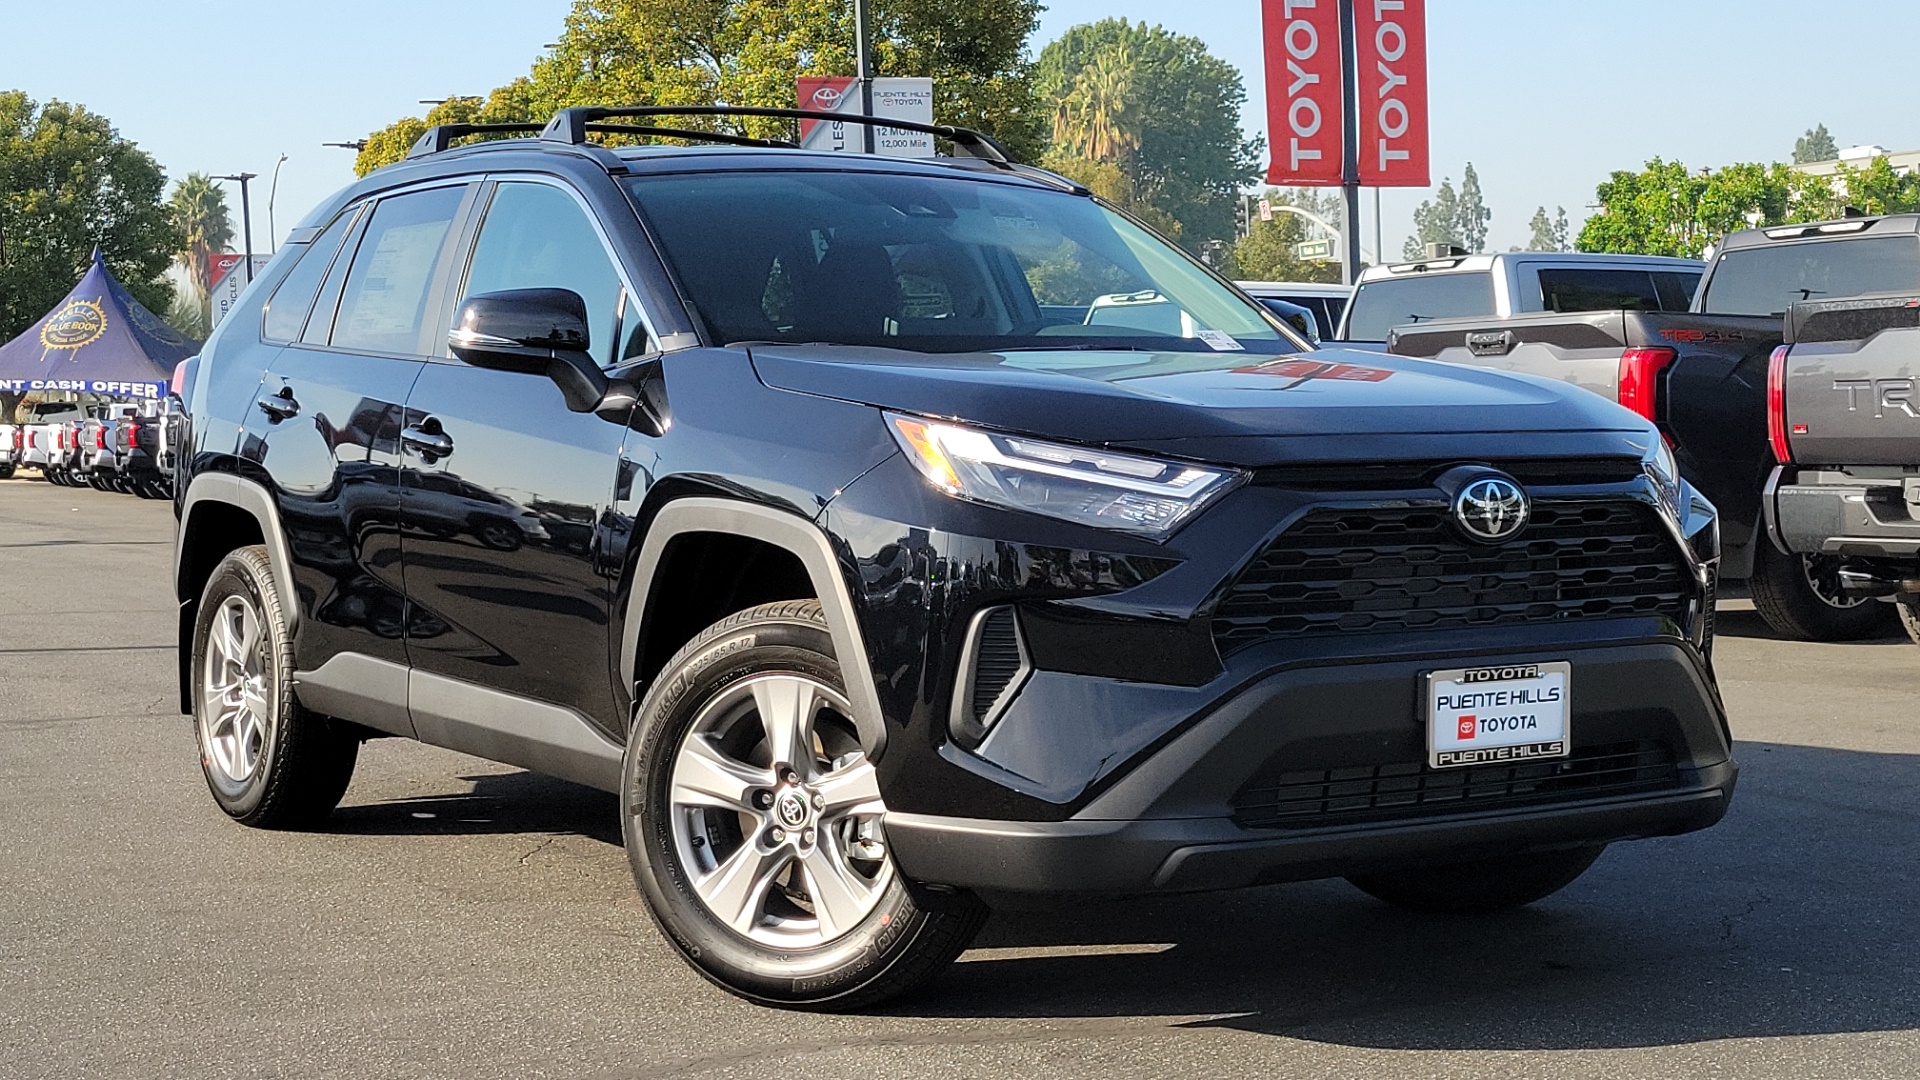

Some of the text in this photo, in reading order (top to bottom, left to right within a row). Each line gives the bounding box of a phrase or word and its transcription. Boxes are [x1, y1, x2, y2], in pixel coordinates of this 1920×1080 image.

[876, 127, 888, 136] 12
[881, 139, 928, 148] 12,000 Mile
[58, 306, 100, 321] KELLEY
[48, 321, 99, 333] BLUE BOOK
[30, 380, 86, 391] CASH
[92, 380, 158, 399] OFFER
[1465, 666, 1538, 683] TOYOTA
[1437, 687, 1560, 711] PUENTE HILLS
[1479, 714, 1538, 733] TOYOTA
[1439, 742, 1562, 765] PUENTE HILLS
